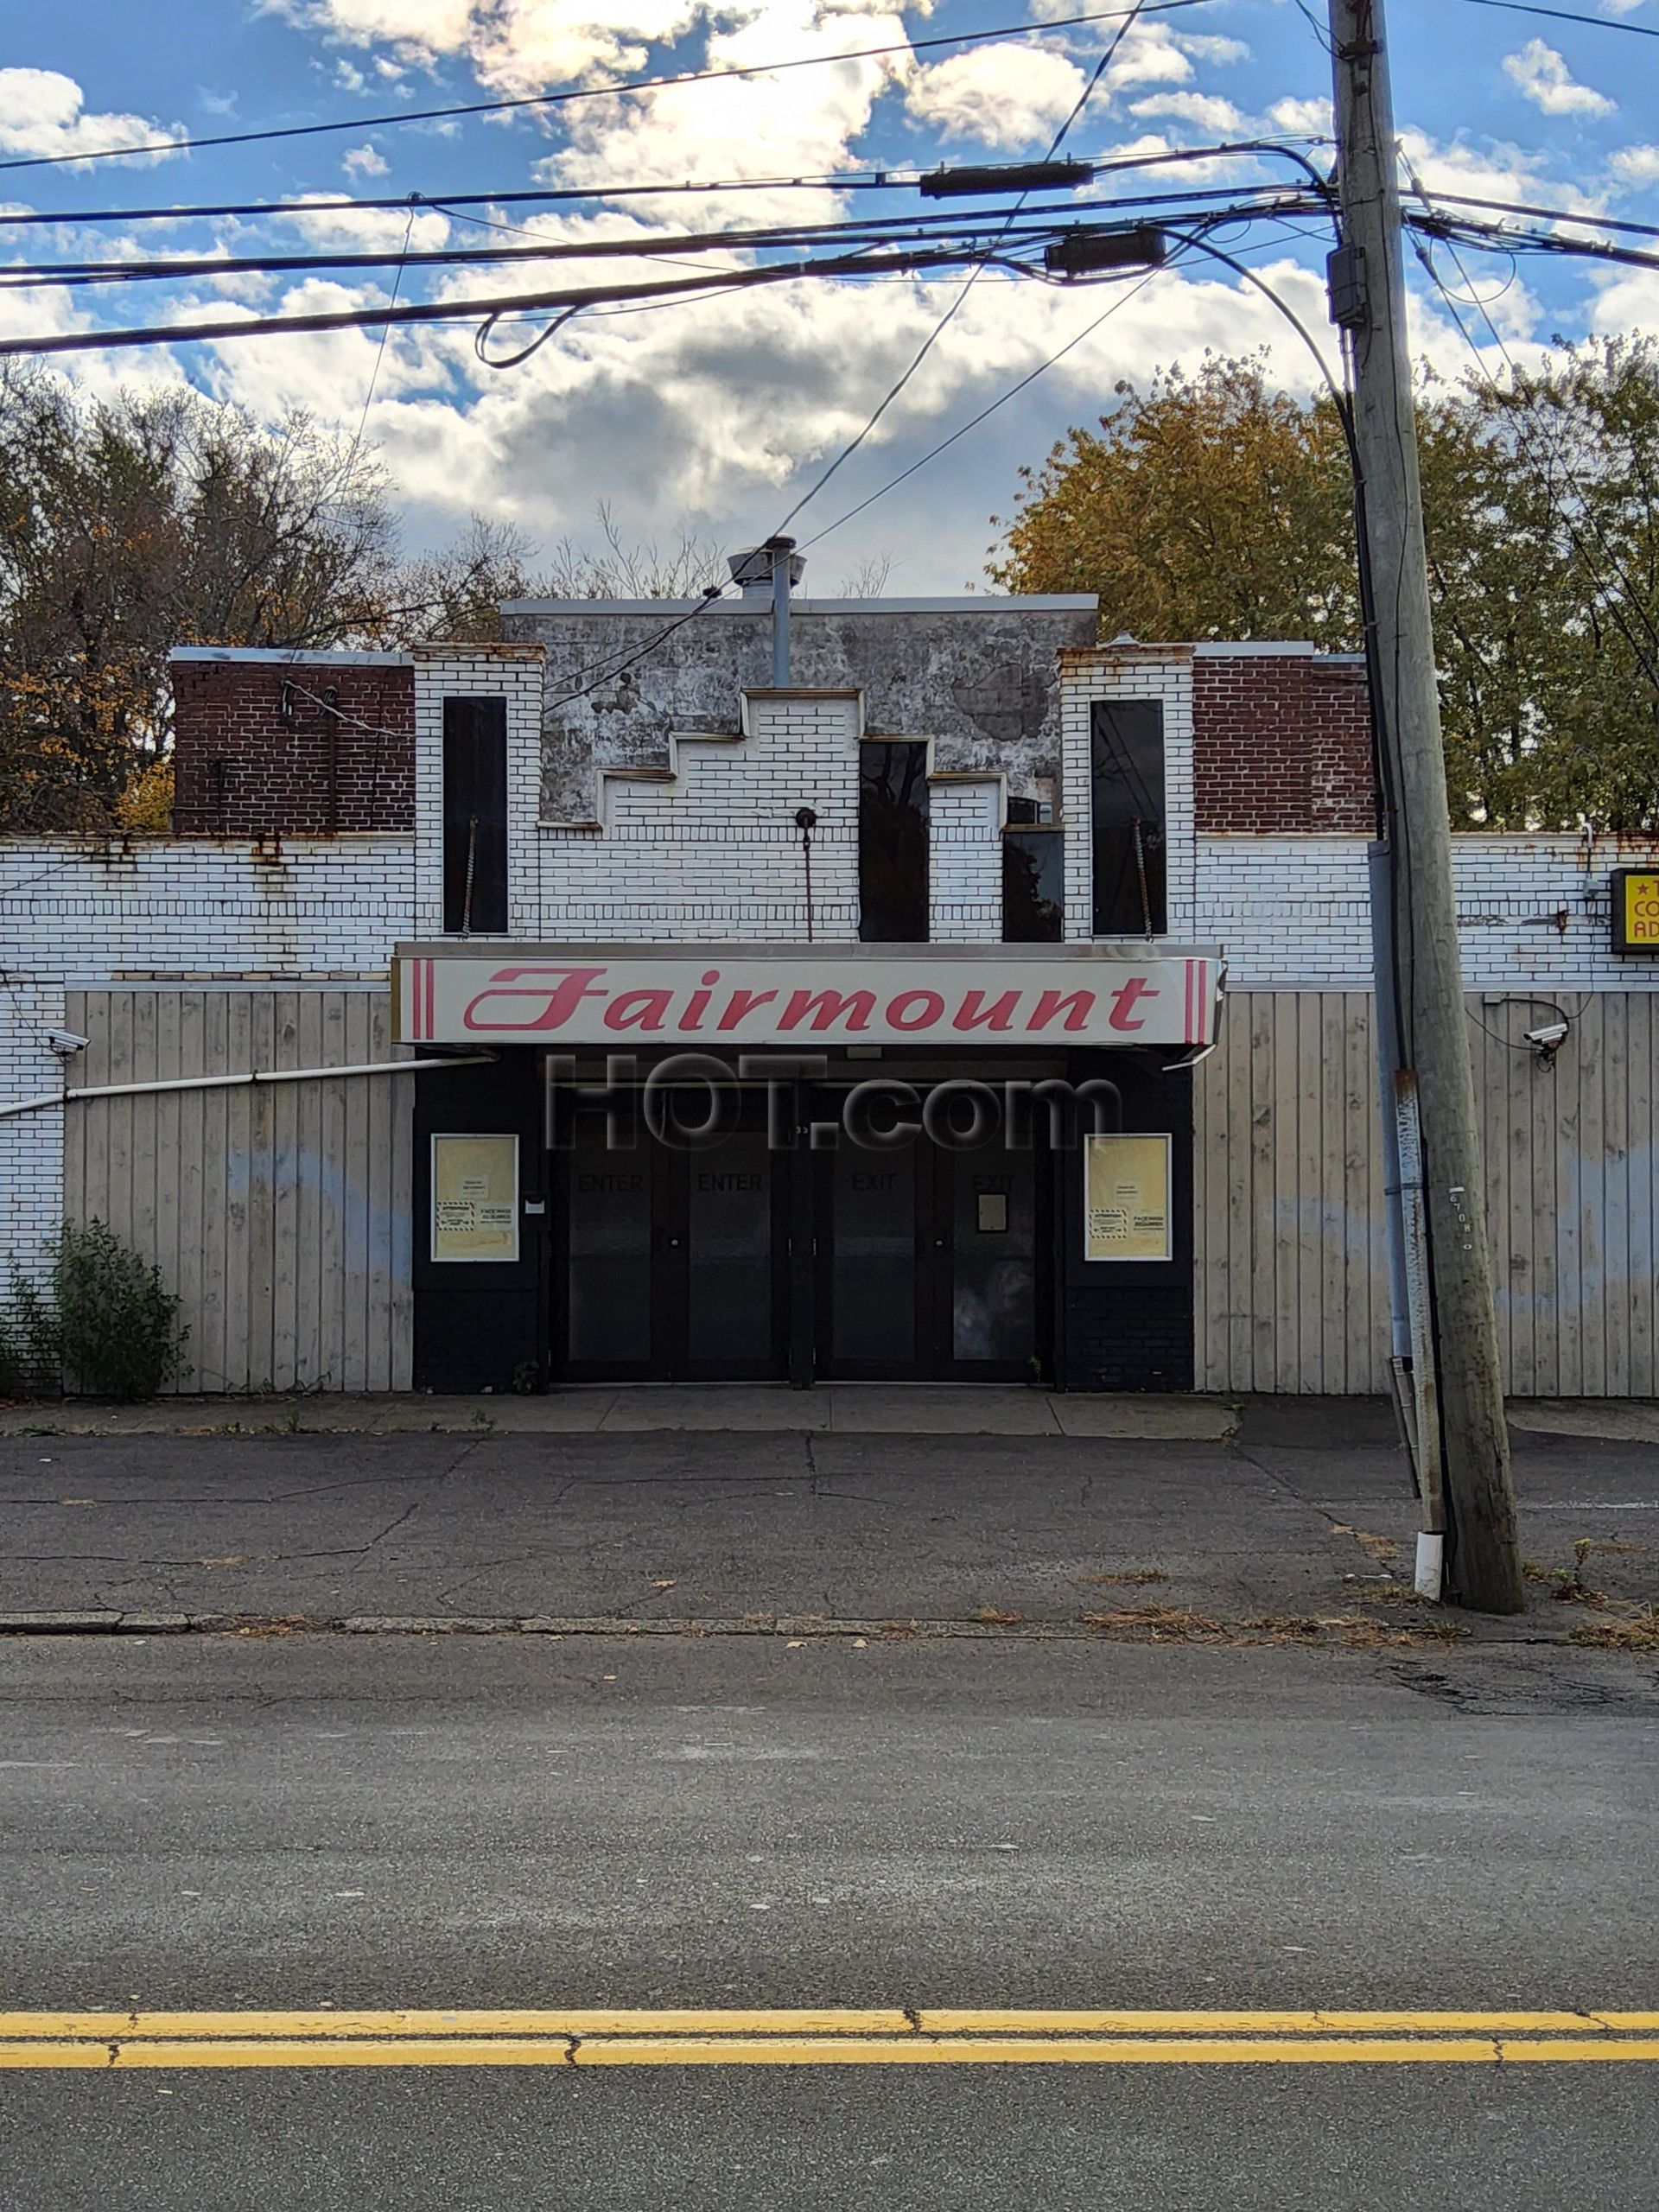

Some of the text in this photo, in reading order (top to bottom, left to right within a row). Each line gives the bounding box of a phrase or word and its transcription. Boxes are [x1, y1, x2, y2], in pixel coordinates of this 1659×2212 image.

[462, 968, 1160, 1033] Fairmount
[578, 1173, 644, 1192] ENTER
[698, 1173, 762, 1192] ENTER
[851, 1173, 897, 1191] EXIT
